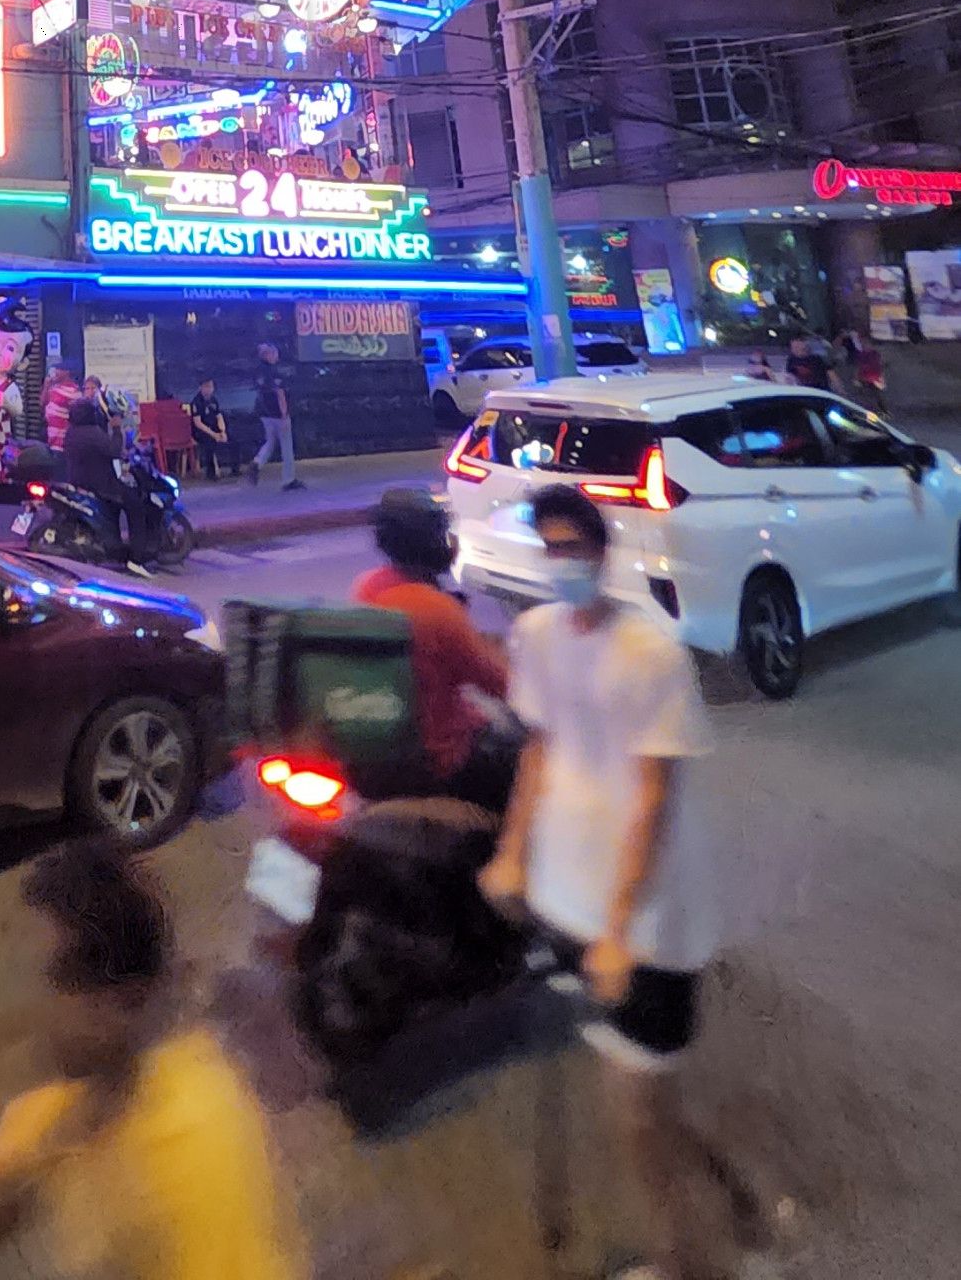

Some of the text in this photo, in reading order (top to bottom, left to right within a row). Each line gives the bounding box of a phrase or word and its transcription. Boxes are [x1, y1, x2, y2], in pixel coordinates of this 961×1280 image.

[240, 170, 298, 217] 24
[91, 219, 432, 260] BREAKFAST LUNCH DINNER
